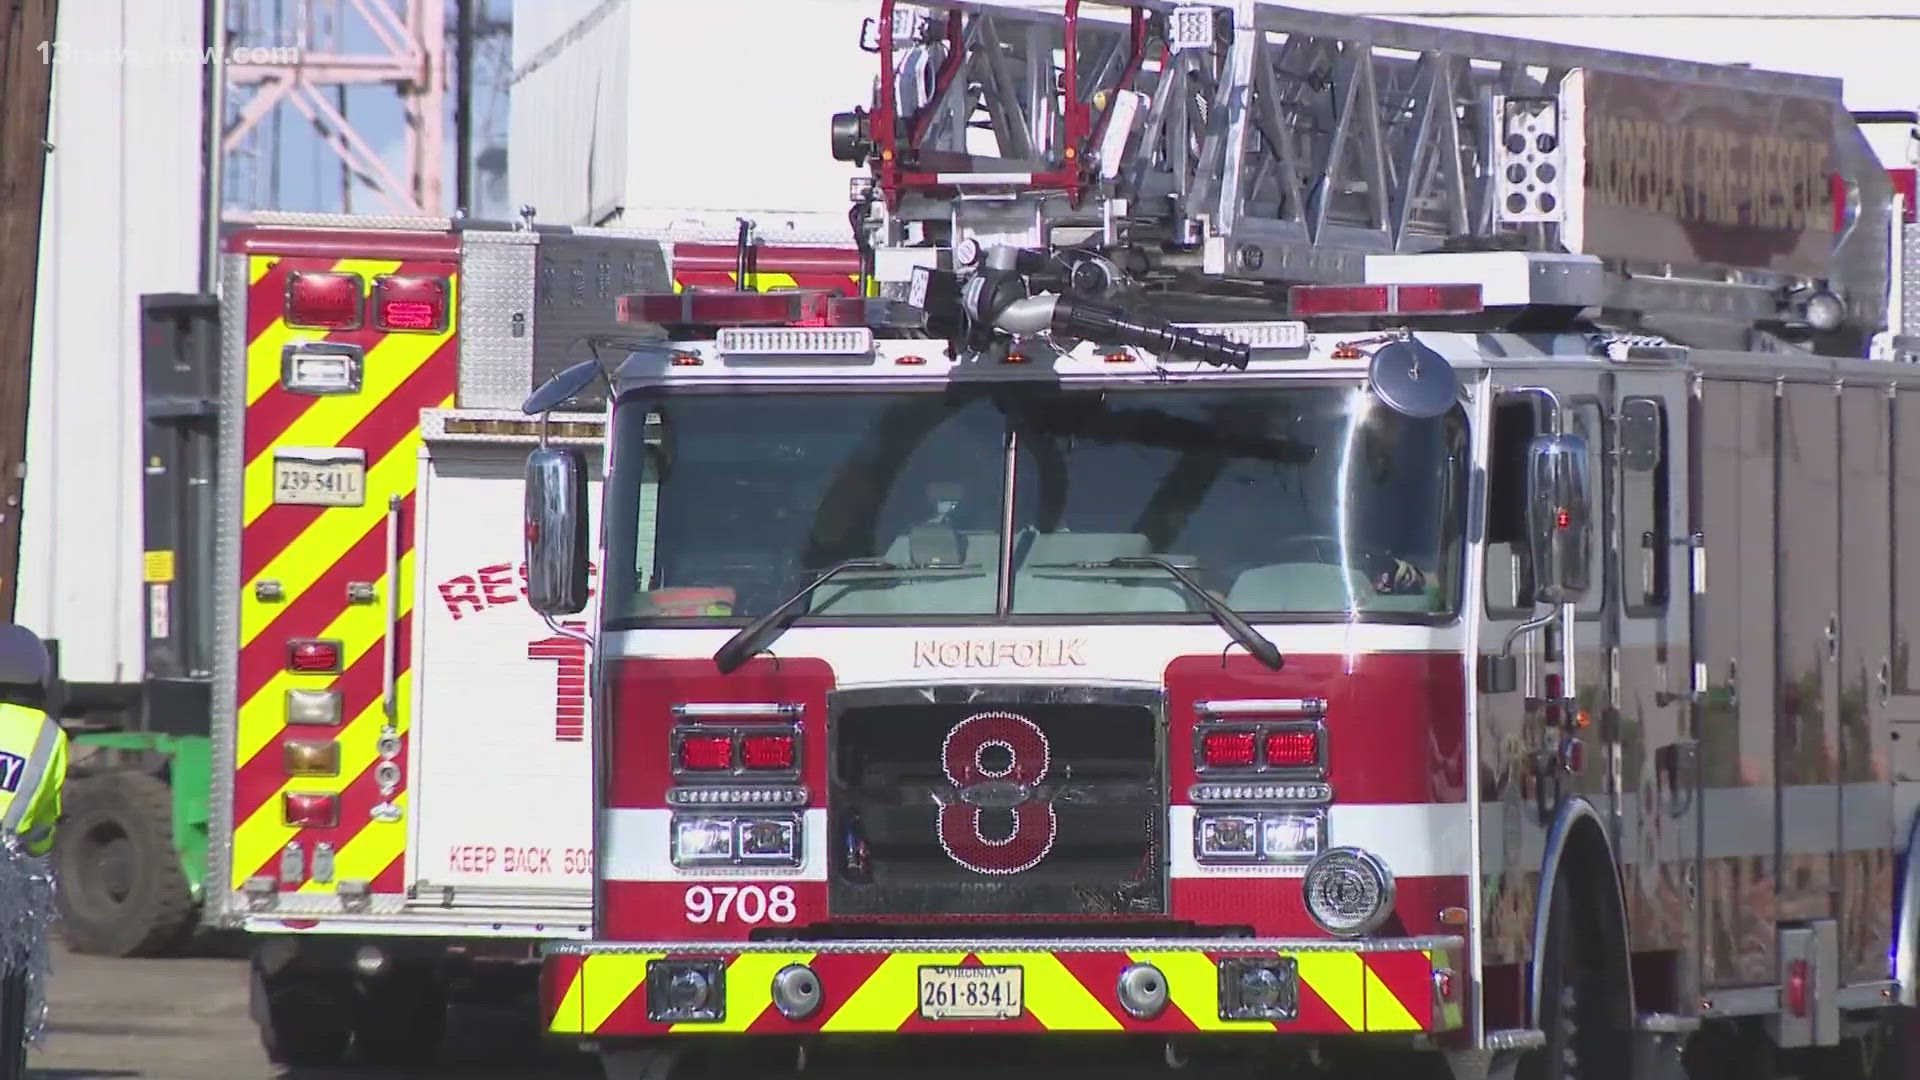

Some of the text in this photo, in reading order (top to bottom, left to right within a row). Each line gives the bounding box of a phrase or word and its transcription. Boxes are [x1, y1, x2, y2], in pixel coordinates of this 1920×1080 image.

[1593, 113, 1687, 219] NORFOLK
[913, 637, 1087, 668] NORFOLK
[936, 711, 1057, 876] 8
[450, 845, 496, 873] KEEP
[504, 847, 551, 874] BACK
[685, 885, 797, 924] 9708
[946, 968, 996, 978] VIRGINIA
